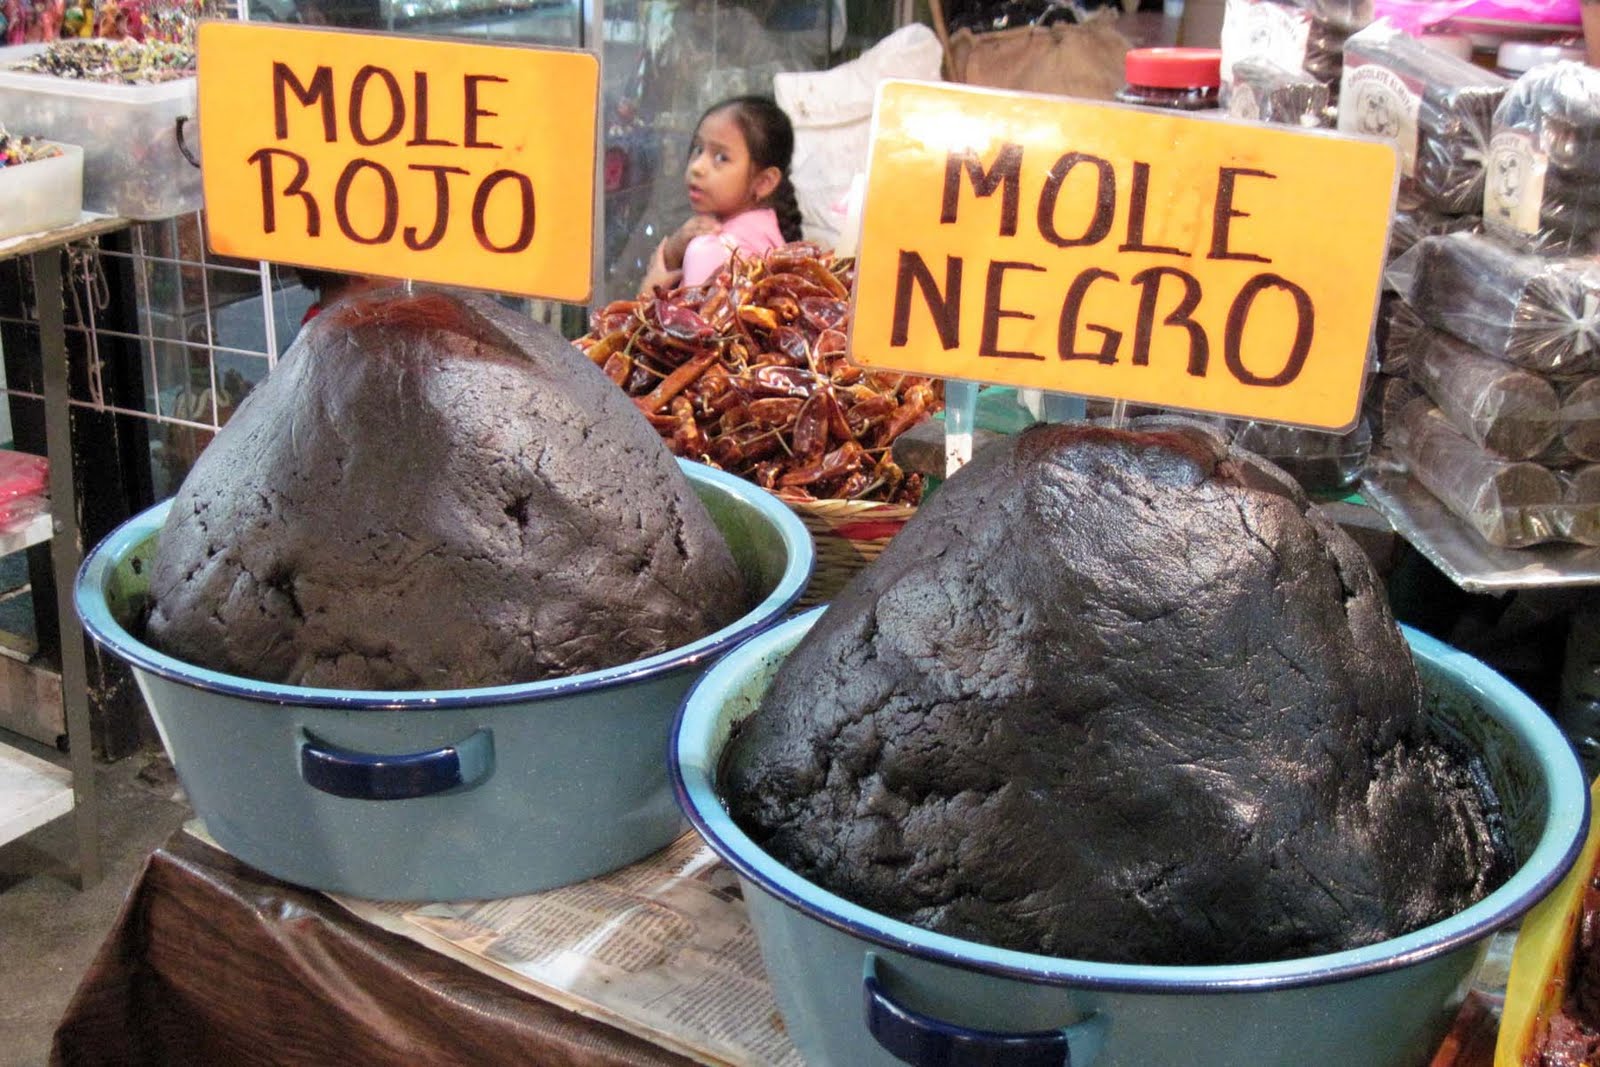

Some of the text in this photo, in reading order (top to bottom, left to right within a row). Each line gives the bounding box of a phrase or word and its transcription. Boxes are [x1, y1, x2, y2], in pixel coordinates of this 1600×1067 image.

[273, 60, 508, 149] MOLE
[247, 147, 536, 254] ROJO
[940, 144, 1277, 263] MOLE
[889, 249, 1315, 388] NEGRO
